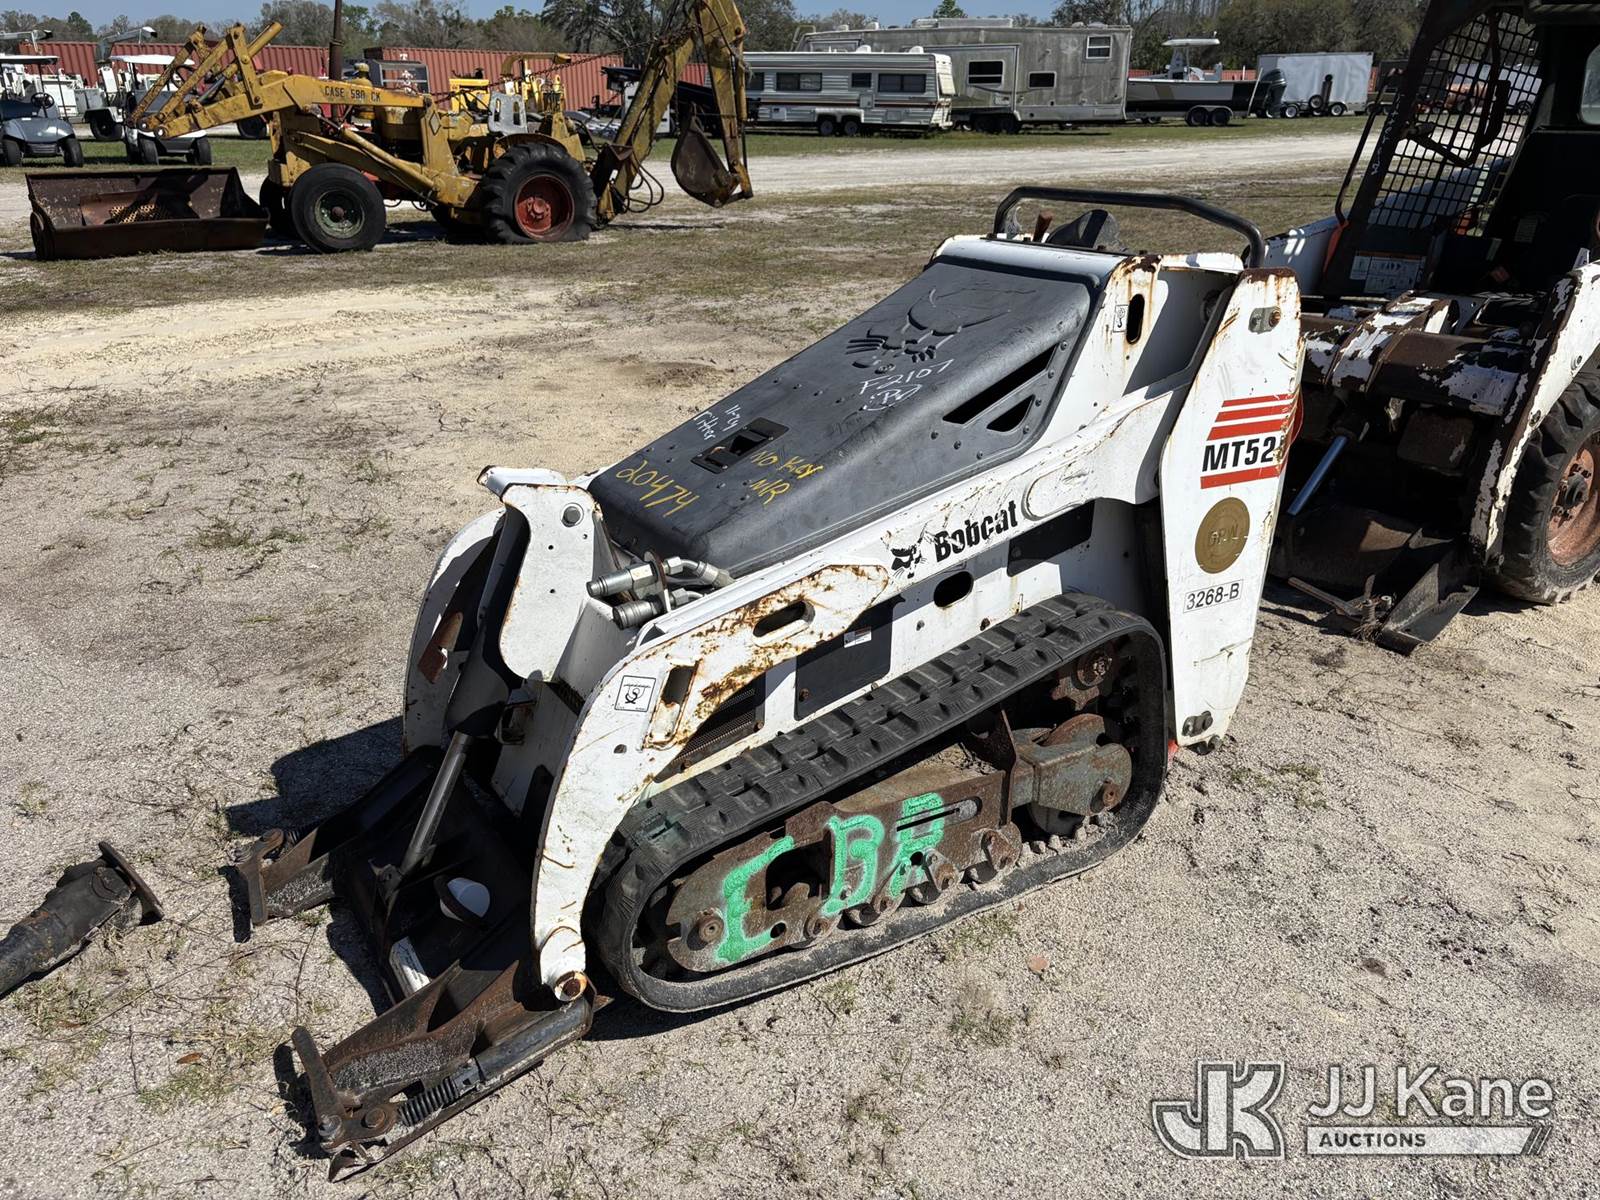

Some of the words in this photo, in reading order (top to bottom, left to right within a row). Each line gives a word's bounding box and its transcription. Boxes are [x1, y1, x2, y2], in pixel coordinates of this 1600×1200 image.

[325, 86, 344, 98] CASE
[859, 359, 955, 395] F2107
[1202, 435, 1285, 472] MT52
[615, 460, 699, 518] 20474
[934, 500, 1018, 562] Bobcat
[1186, 583, 1240, 610] 3268-B
